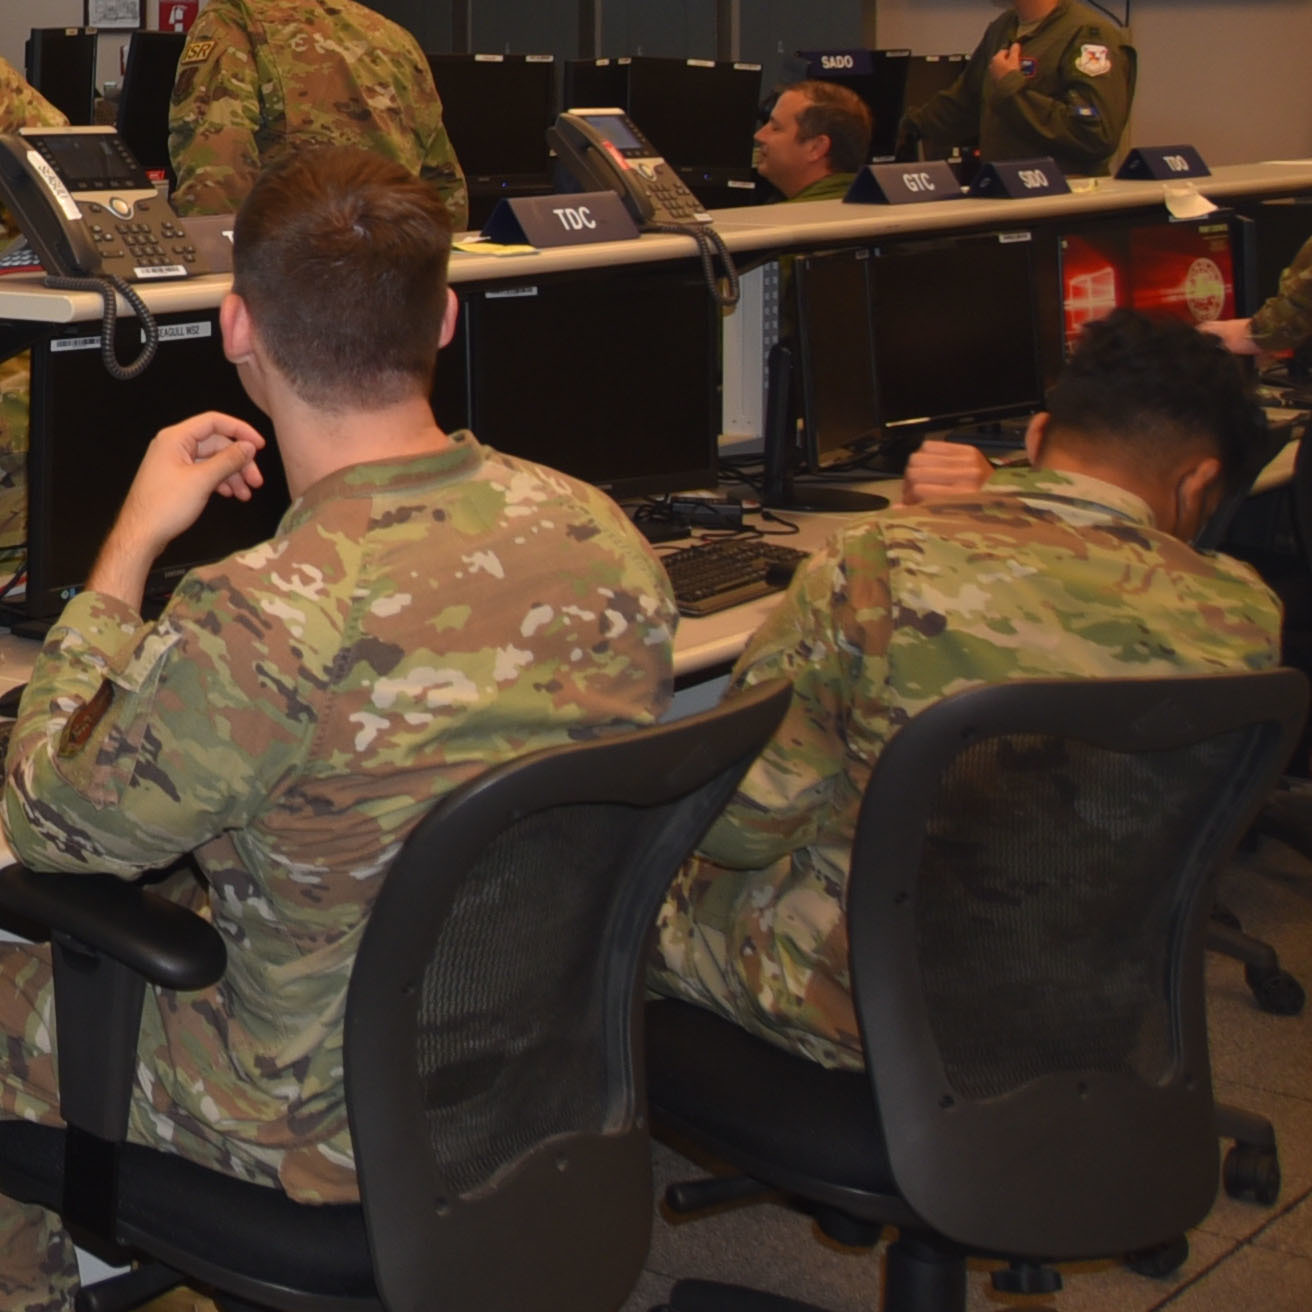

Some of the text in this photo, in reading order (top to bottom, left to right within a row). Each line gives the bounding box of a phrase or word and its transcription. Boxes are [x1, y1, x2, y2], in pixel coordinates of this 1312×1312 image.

[821, 55, 854, 69] SADO
[1162, 155, 1190, 172] TDO
[902, 173, 936, 192] GTC
[1018, 169, 1049, 189] SIDO
[553, 206, 596, 231] TDC
[186, 324, 200, 336] WS2
